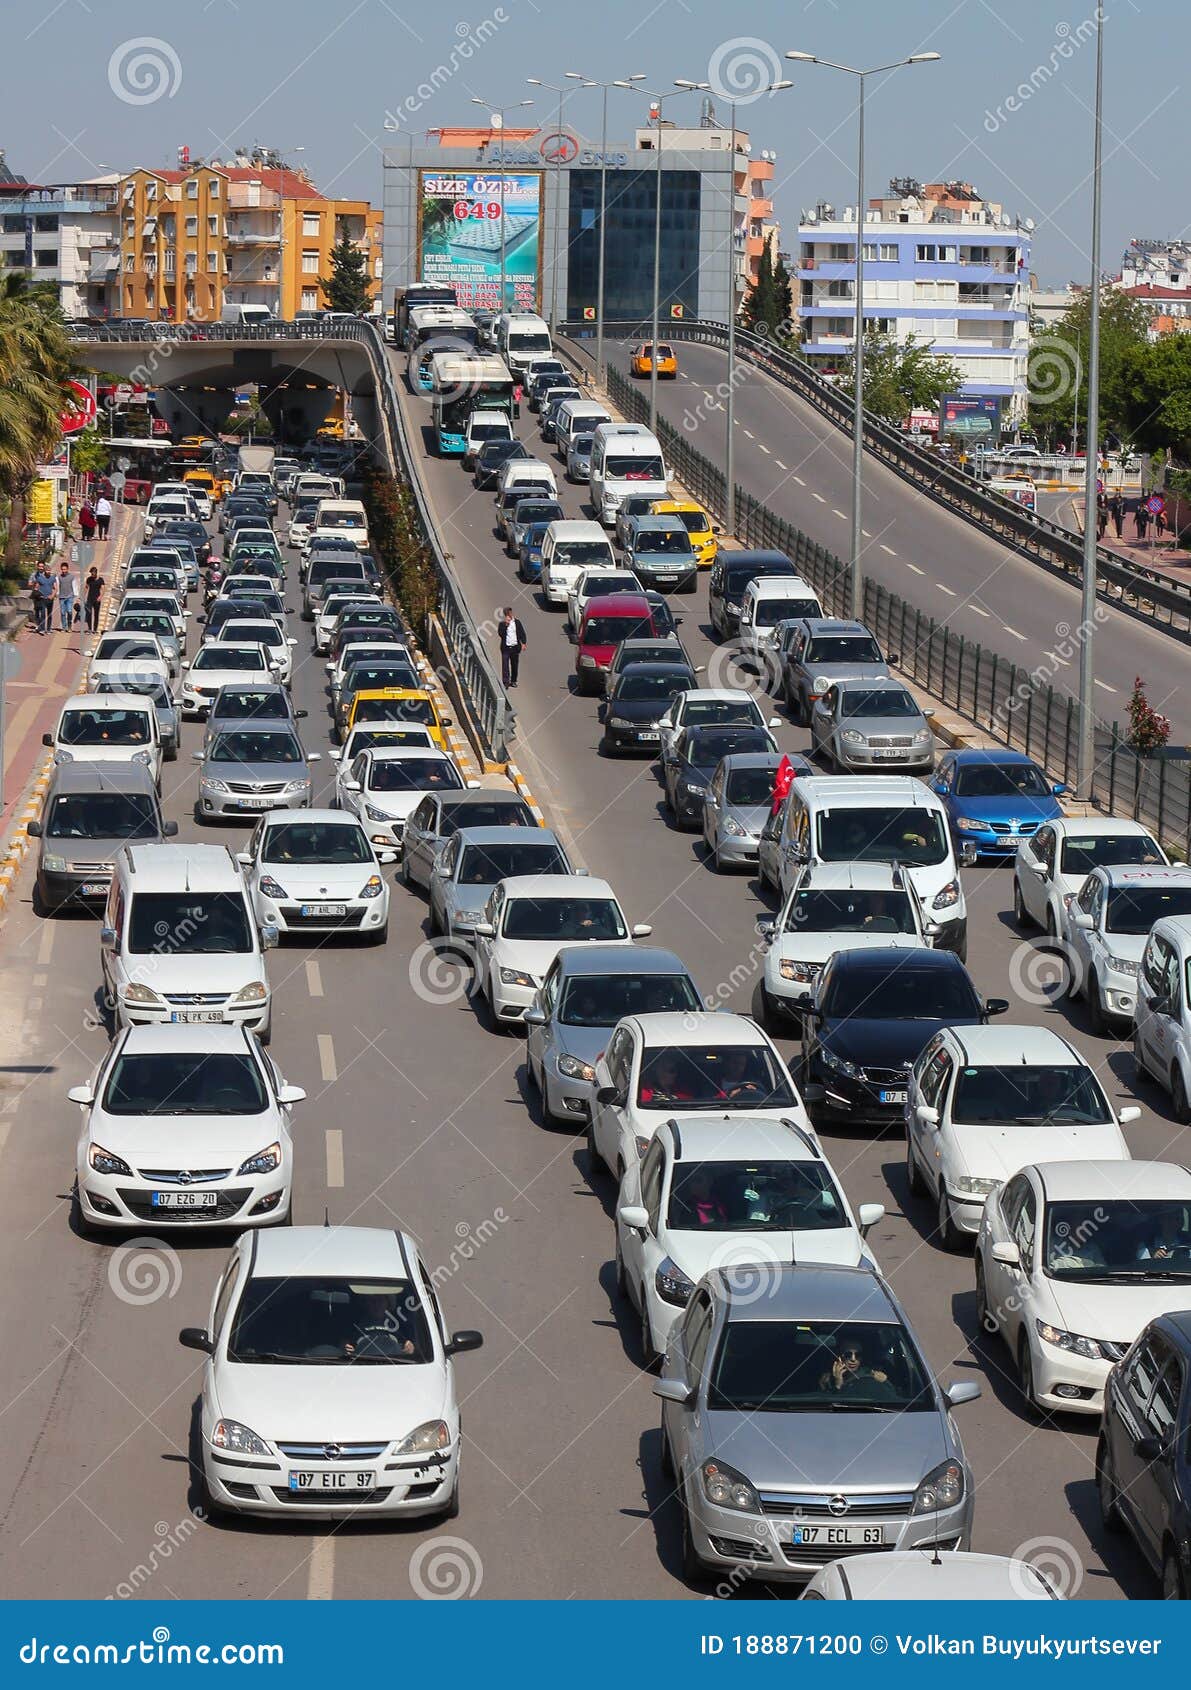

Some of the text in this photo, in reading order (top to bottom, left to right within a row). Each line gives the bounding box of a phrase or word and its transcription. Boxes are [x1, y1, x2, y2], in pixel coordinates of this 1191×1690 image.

[453, 200, 502, 220] 649
[885, 1092, 896, 1102] 07
[159, 1194, 171, 1205] 07
[202, 1194, 215, 1204] 20
[298, 1473, 372, 1487] 07 EIC 97
[802, 1528, 880, 1543] 07 ECL 63
